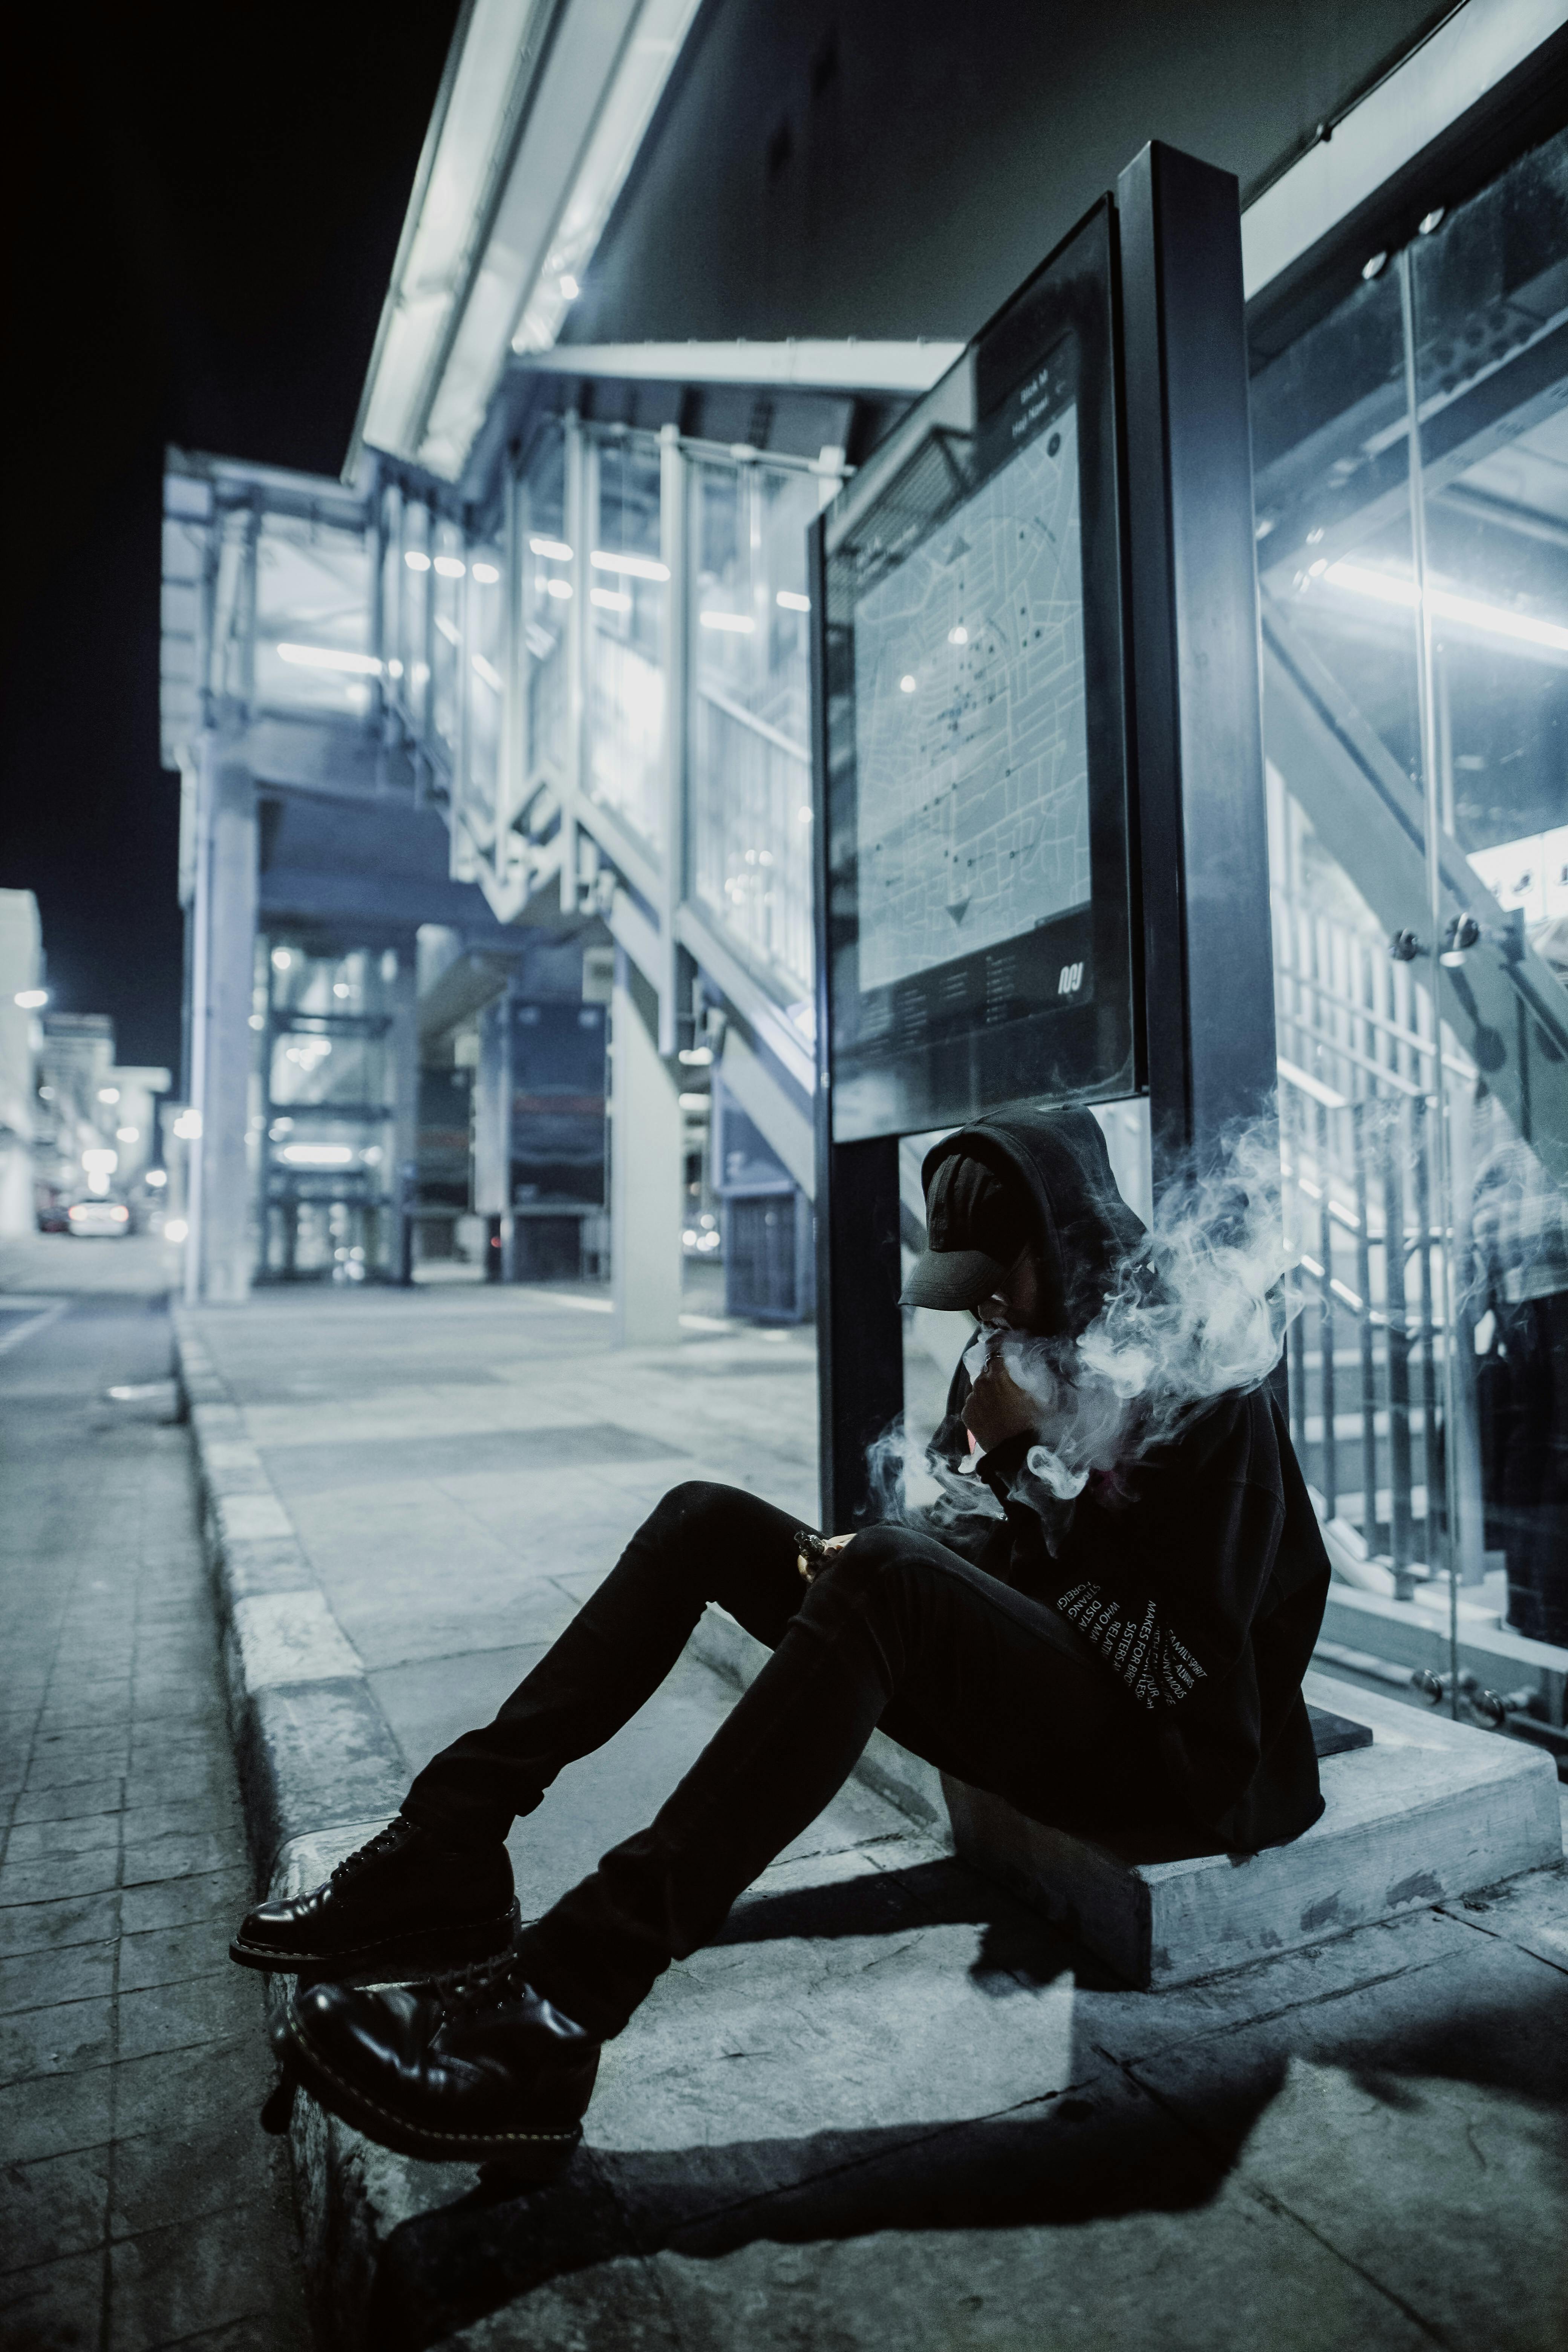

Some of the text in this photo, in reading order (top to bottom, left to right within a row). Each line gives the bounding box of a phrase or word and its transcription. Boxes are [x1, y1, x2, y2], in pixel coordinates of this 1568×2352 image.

[1099, 1602, 1121, 1625] WHO
[1139, 1600, 1157, 1640] MAKES
[1115, 1621, 1136, 1661] SISTERS
[1131, 1640, 1146, 1664] FOR
[1188, 1658, 1208, 1677] SPIRIT
[1146, 1675, 1159, 1697] OUR
